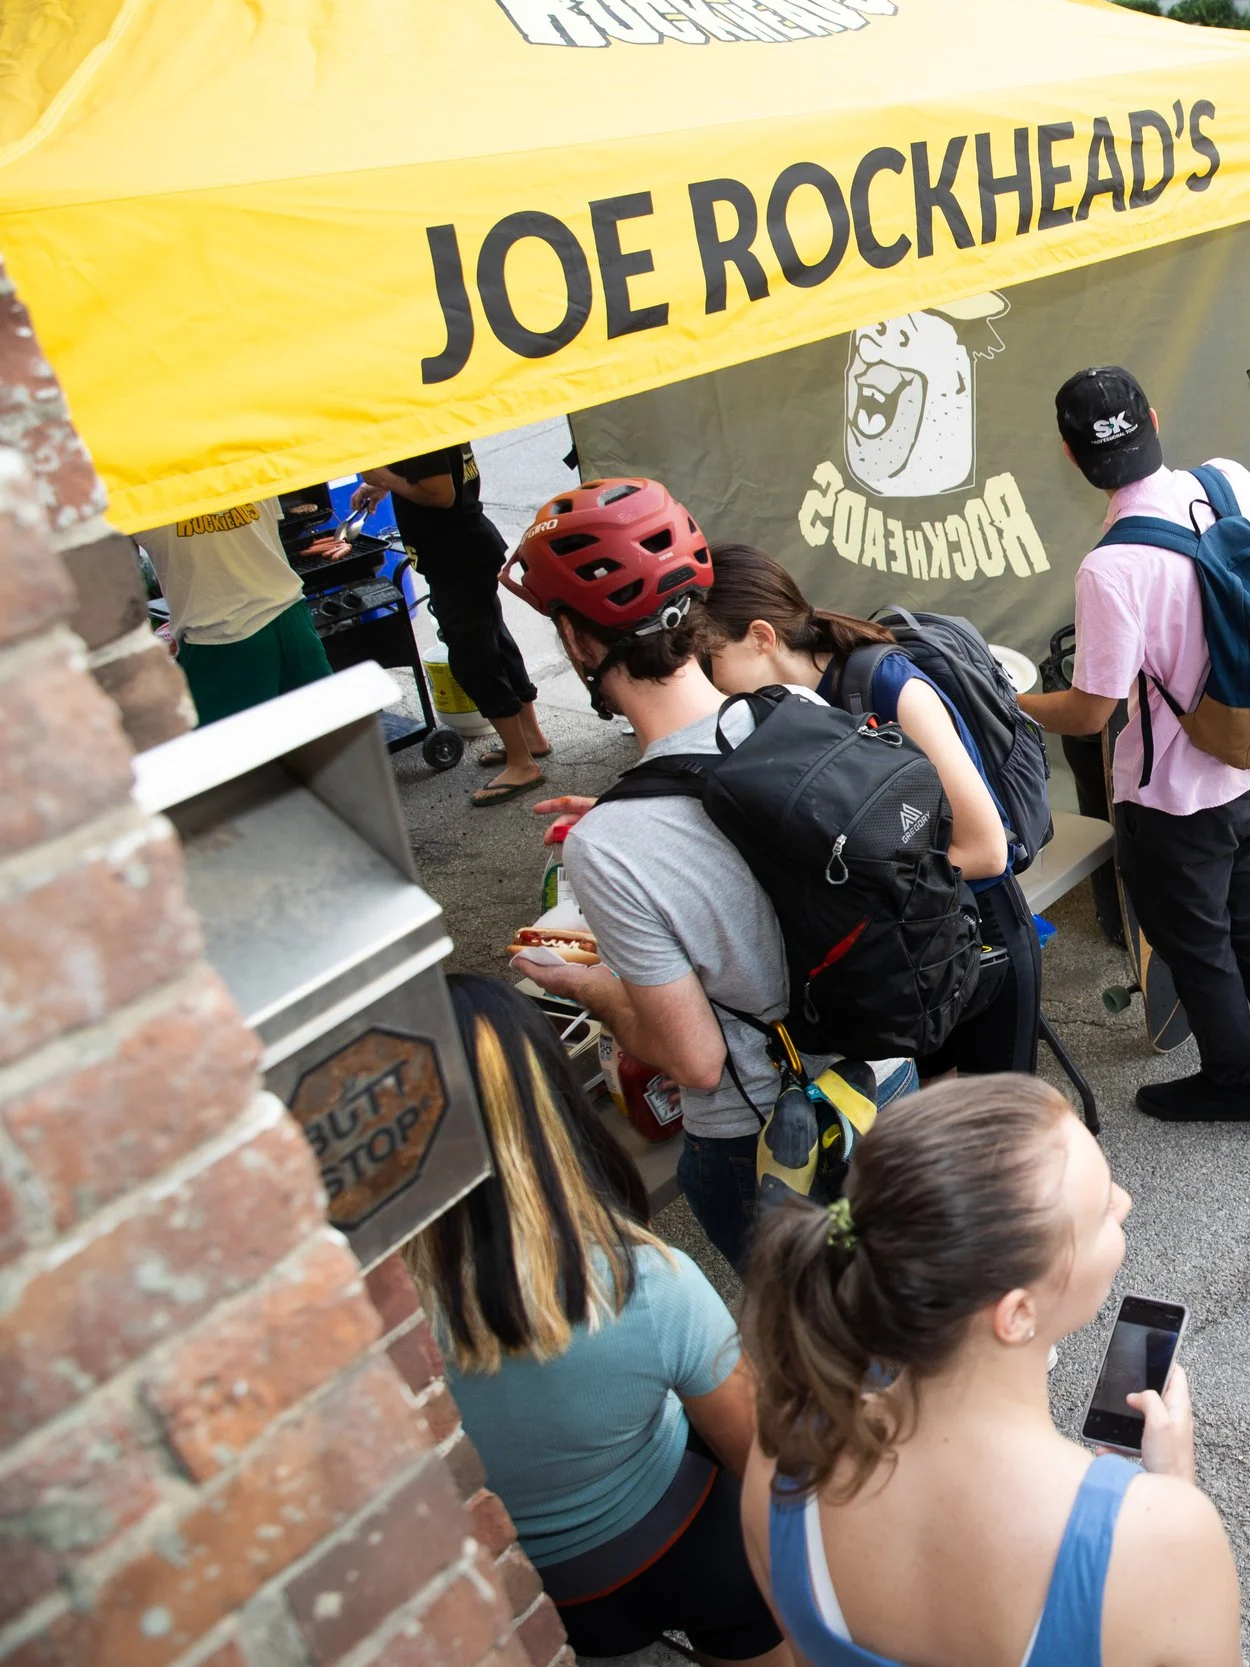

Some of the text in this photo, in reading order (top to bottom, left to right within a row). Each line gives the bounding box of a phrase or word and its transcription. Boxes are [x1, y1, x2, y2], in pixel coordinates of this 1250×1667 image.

[421, 98, 1221, 385] JOE ROCKHEAD'S
[901, 810, 931, 844] GREGORY
[305, 1058, 408, 1156] BUTT
[321, 1104, 419, 1200] STOP
